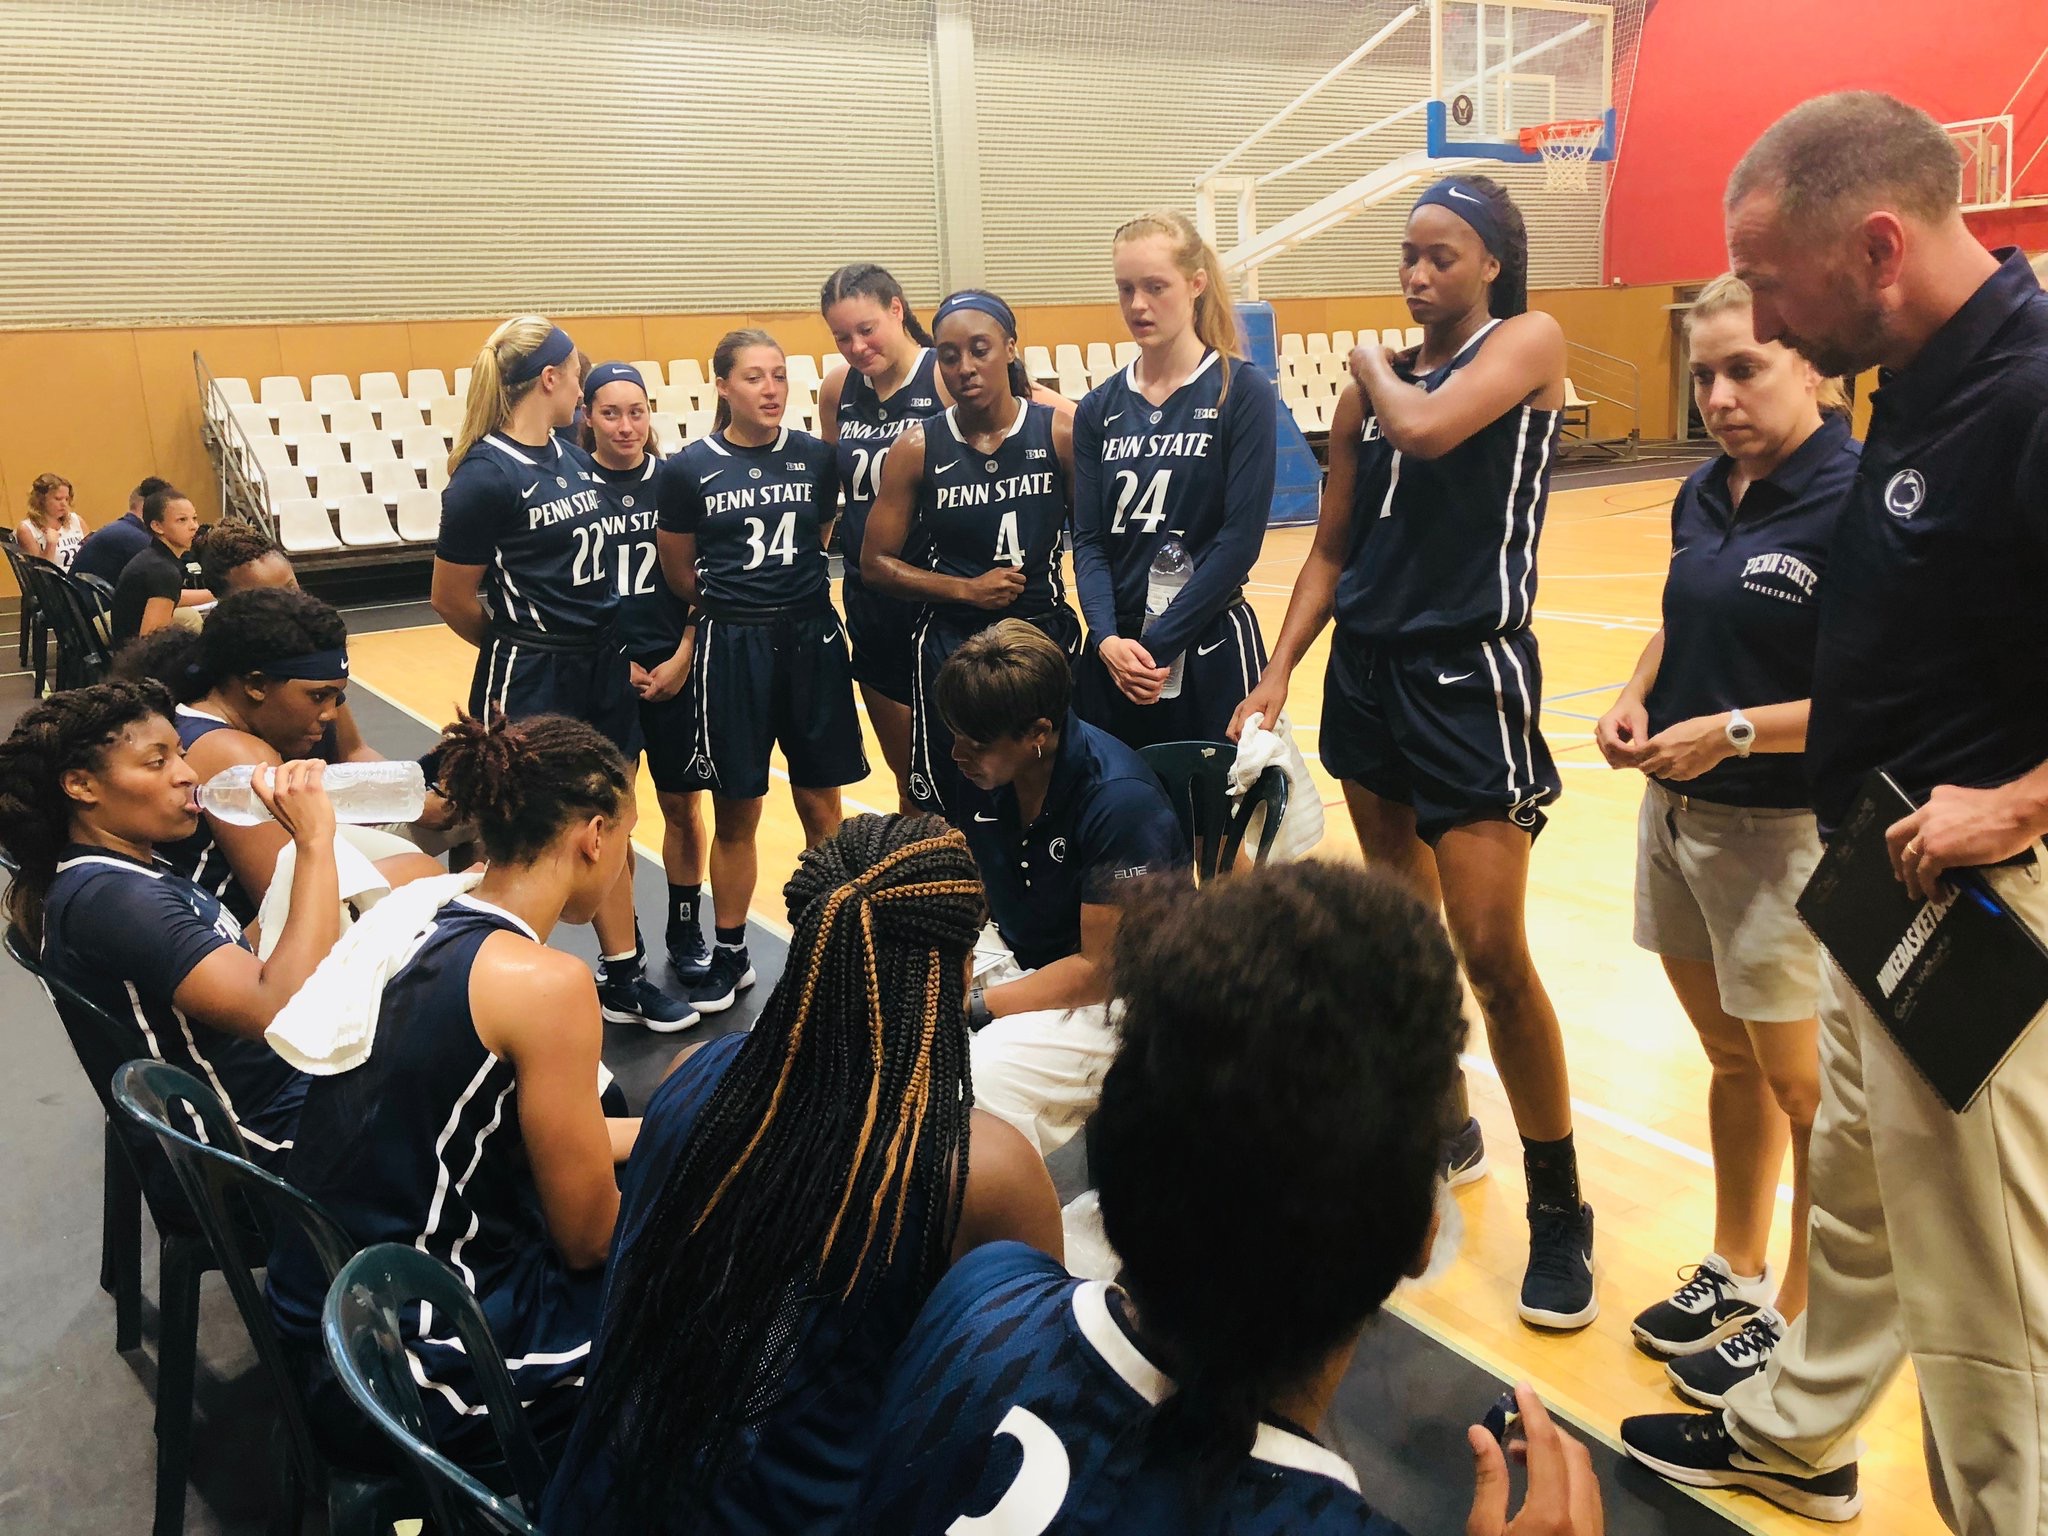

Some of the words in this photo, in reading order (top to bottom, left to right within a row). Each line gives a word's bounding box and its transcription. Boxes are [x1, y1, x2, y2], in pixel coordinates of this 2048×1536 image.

[839, 420, 880, 440] PENN
[873, 418, 924, 439] STAT
[1145, 432, 1213, 457] STATE
[529, 497, 574, 530] PENN
[571, 489, 601, 515] STAT
[705, 488, 755, 516] PENN
[760, 483, 813, 505] STATE
[937, 483, 990, 509] PENN
[994, 472, 1053, 502] STATE
[1111, 469, 1173, 533] 24
[572, 522, 606, 587] 22
[742, 511, 798, 571] 34
[993, 510, 1026, 569] 4
[617, 542, 657, 597] 12
[1740, 553, 1782, 577] PENN
[1778, 555, 1818, 596] STATE
[1743, 581, 1802, 603] BASKETBALL
[1114, 865, 1148, 880] ELITE
